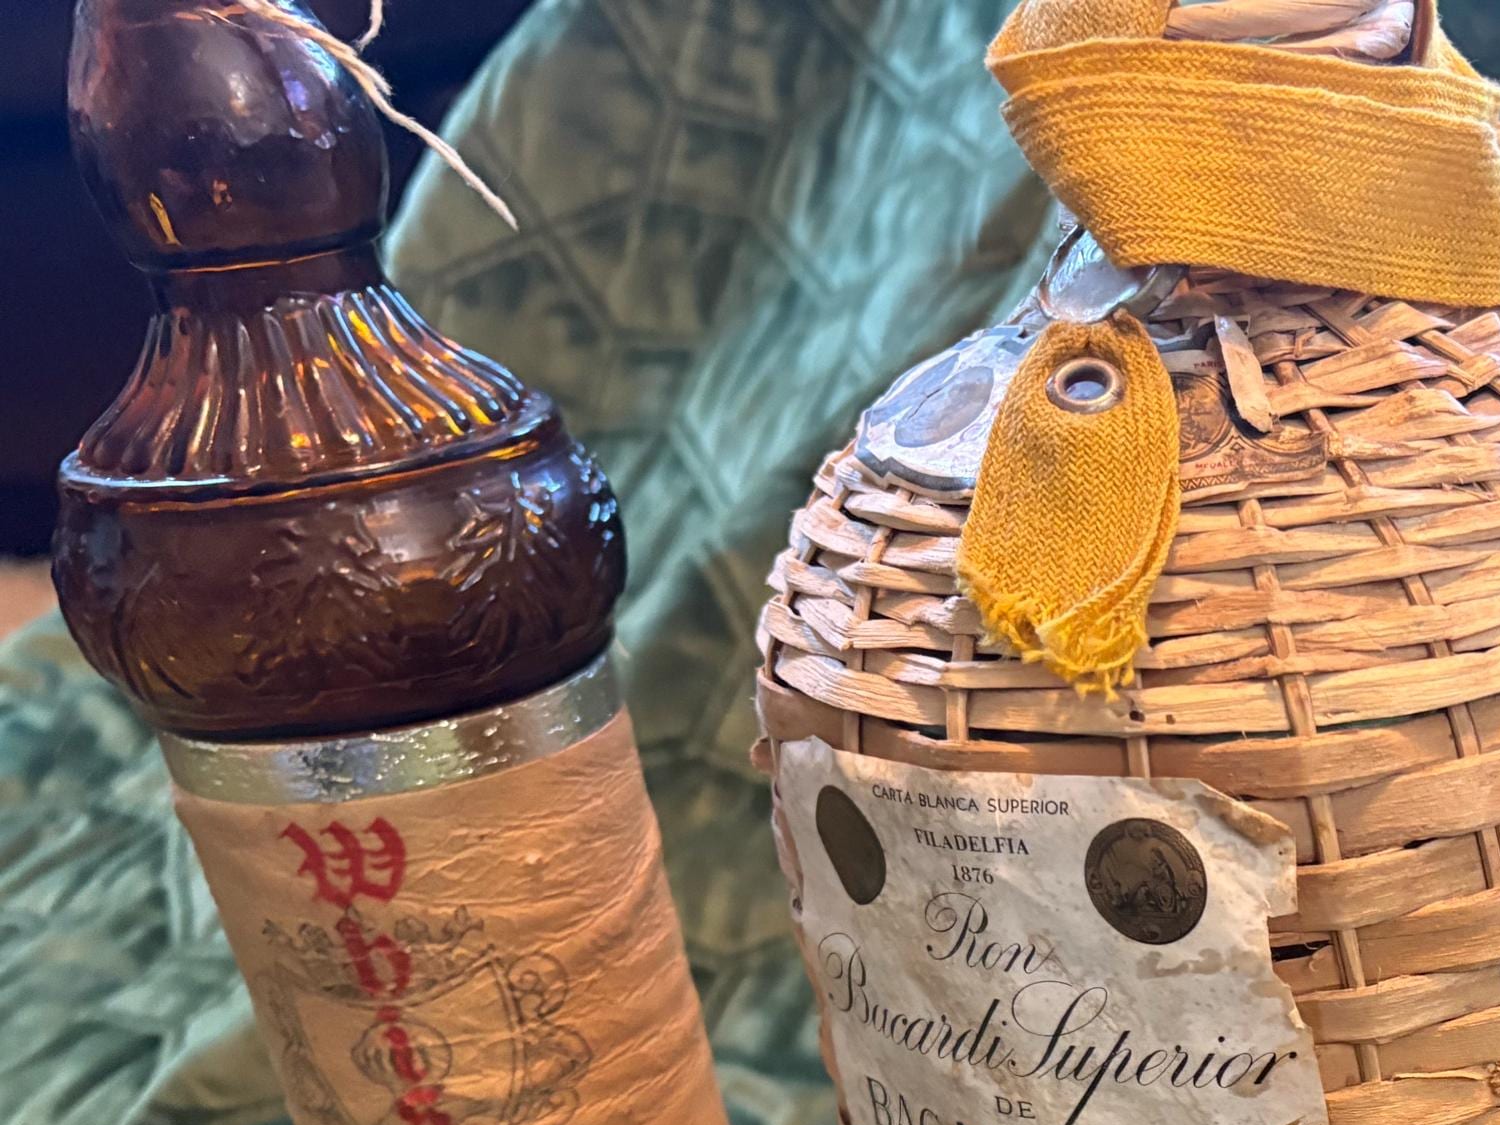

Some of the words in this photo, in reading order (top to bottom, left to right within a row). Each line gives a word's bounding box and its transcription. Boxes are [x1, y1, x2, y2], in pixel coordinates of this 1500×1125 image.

[872, 783, 913, 805] CARTA
[918, 793, 980, 812] BLANCA
[986, 798, 1070, 816] SUPERIOR
[913, 827, 1030, 856] FILADELFIA
[951, 864, 995, 885] 1876
[925, 892, 1058, 974] Ron
[817, 932, 1012, 1069] Bacardi
[994, 1095, 1036, 1120] DE
